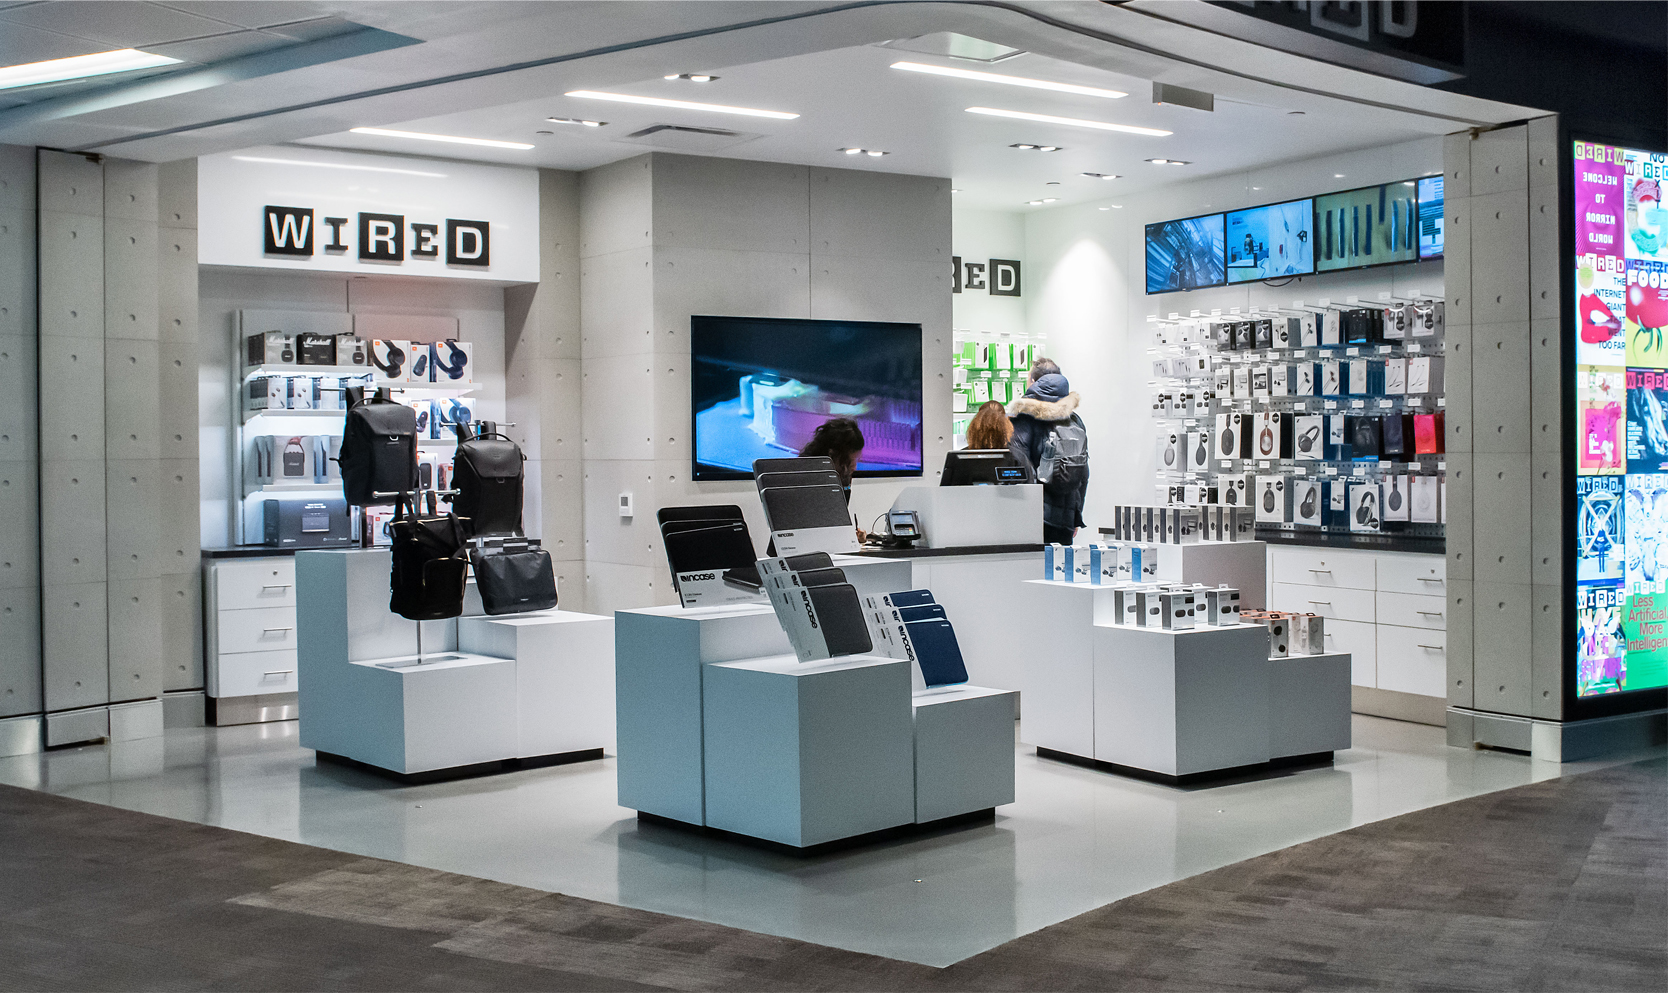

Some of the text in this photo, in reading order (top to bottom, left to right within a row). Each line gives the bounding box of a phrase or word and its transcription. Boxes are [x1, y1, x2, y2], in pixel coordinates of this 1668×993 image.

[1650, 153, 1665, 163] NO
[263, 205, 490, 266] WIRED
[1613, 277, 1626, 287] THE
[1627, 269, 1668, 289] FOOD
[1593, 288, 1626, 299] INTERNET
[1606, 302, 1626, 311] GIANT
[1598, 340, 1626, 350] TOO FAR
[681, 573, 715, 582] incase
[1577, 589, 1626, 609] WIRED
[1633, 595, 1654, 608] Less
[802, 592, 818, 629] incase
[1640, 622, 1663, 636] More
[899, 627, 915, 662] incase
[1627, 636, 1668, 652] Intelligen
